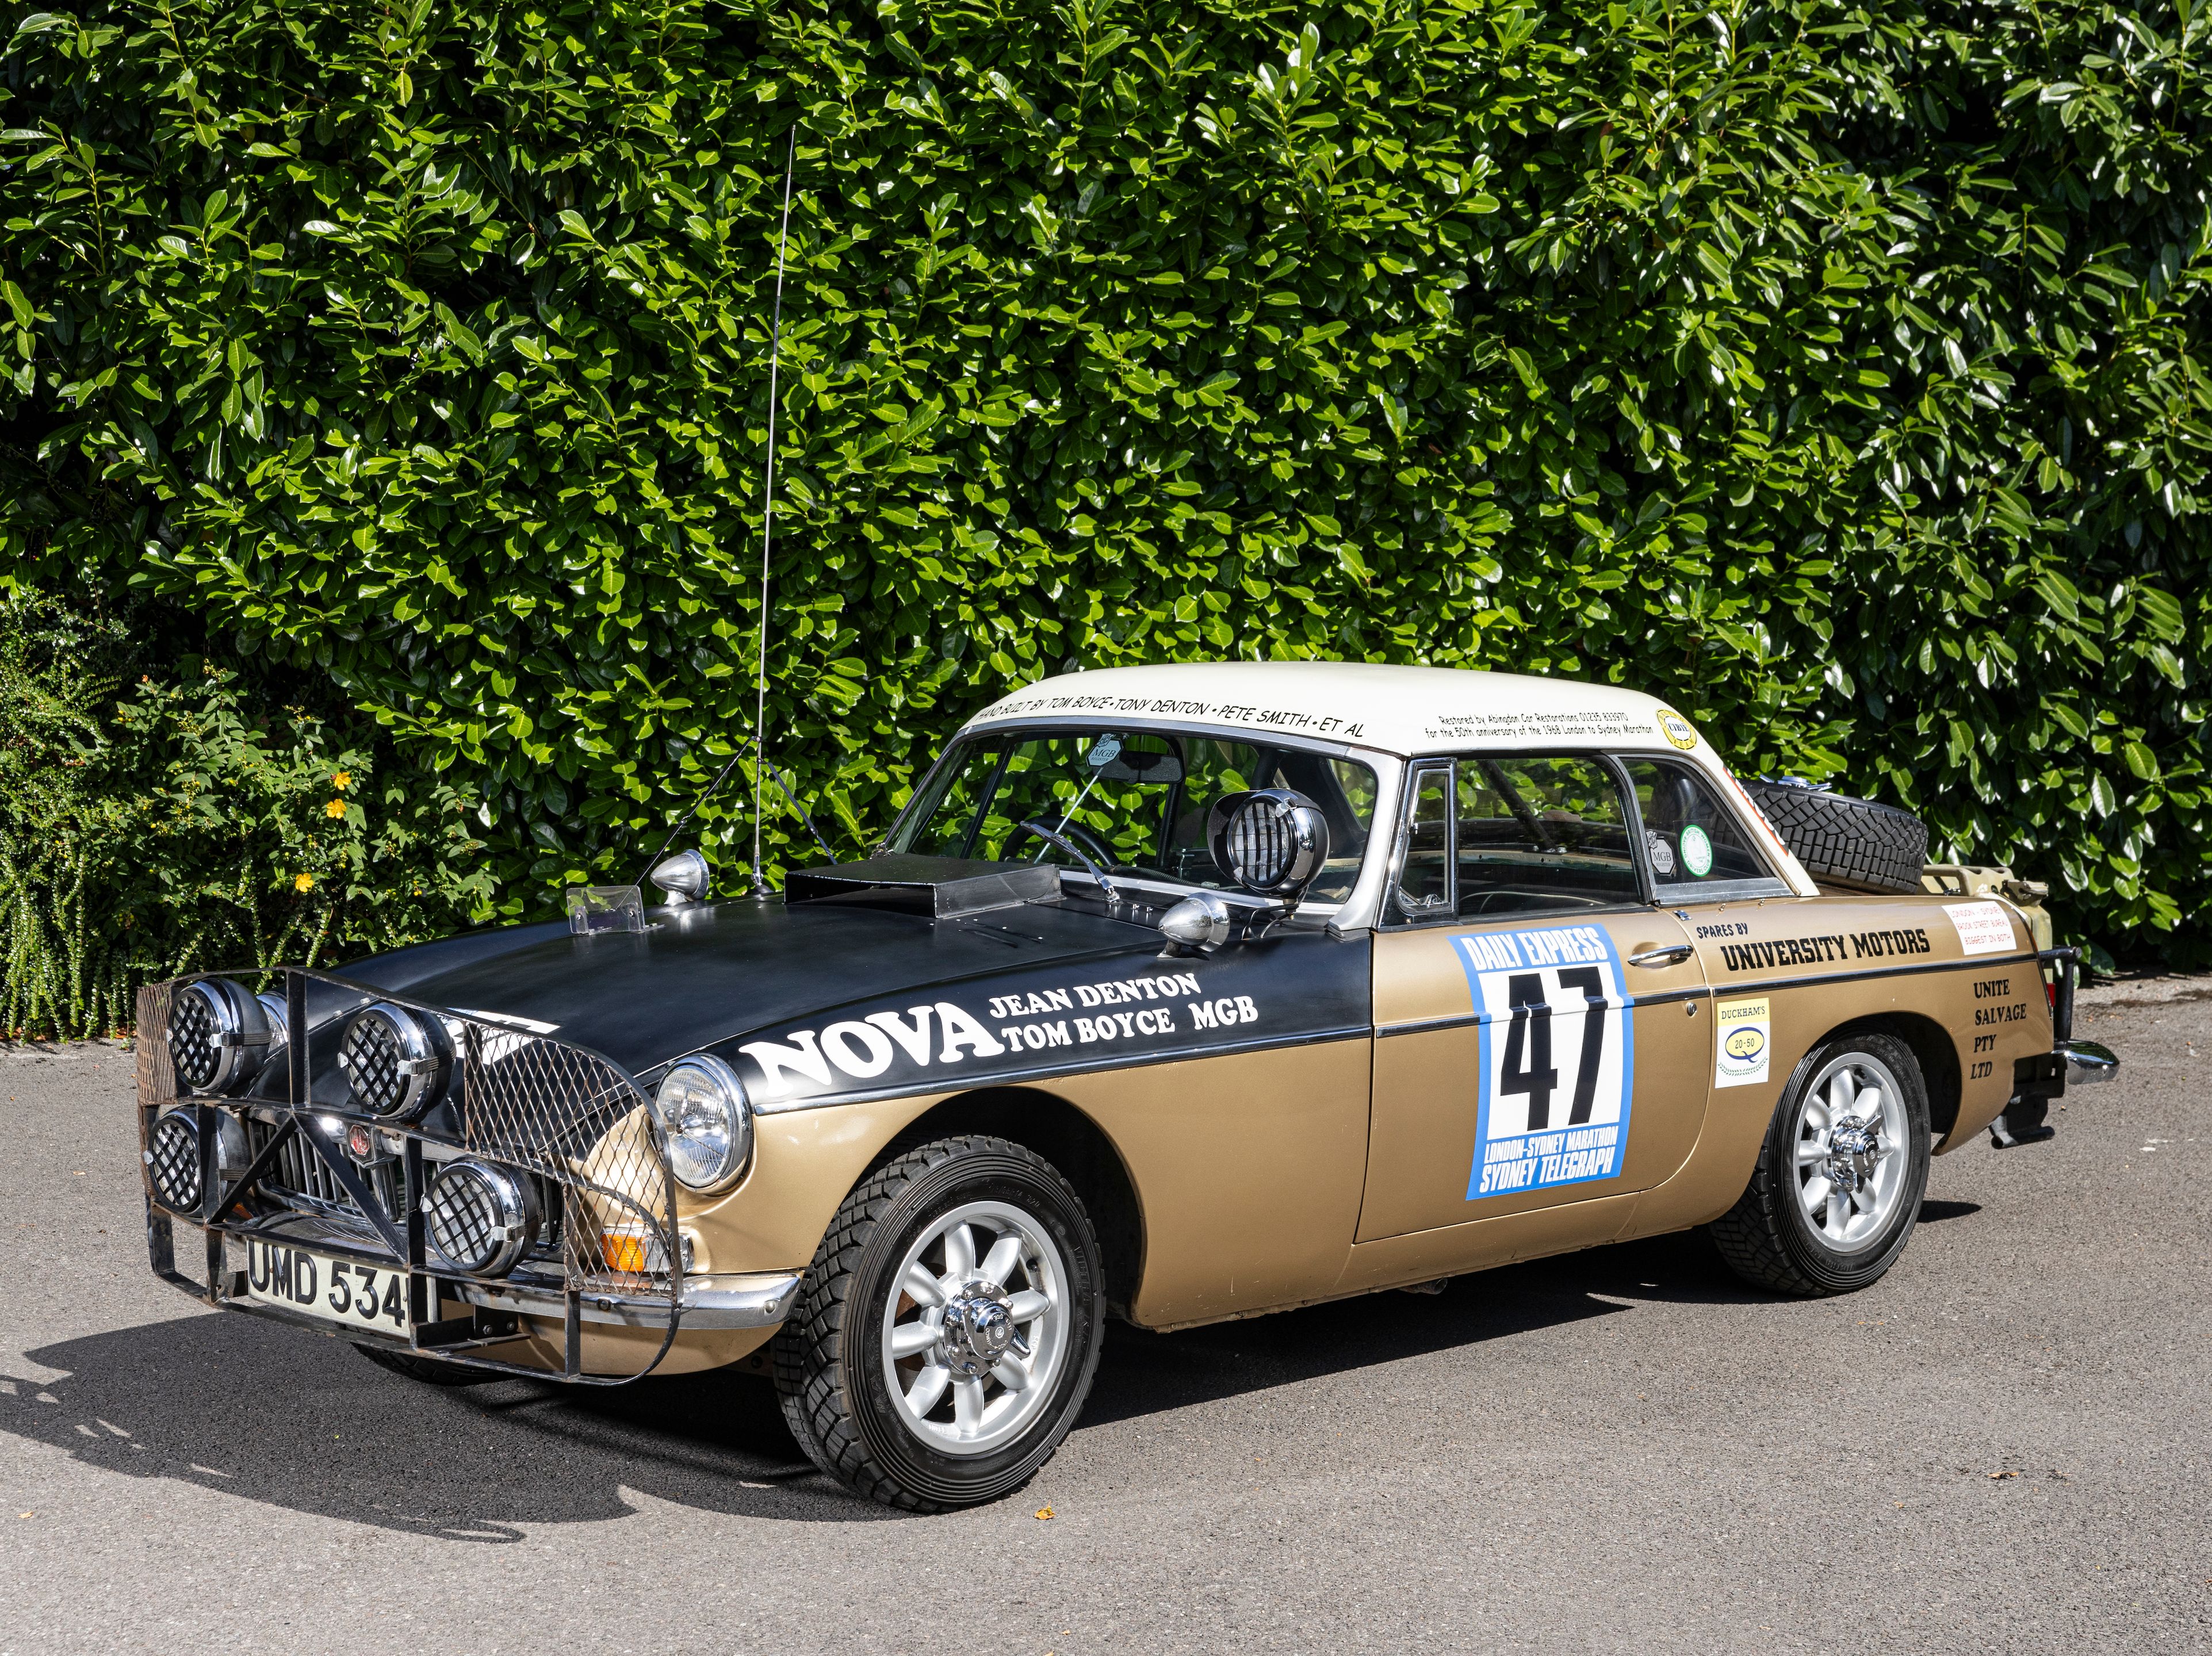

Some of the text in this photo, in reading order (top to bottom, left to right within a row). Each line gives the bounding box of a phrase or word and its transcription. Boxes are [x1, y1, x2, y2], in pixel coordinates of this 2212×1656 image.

[976, 696, 1364, 737] HAND BUILT BY TOM BOYCE TONY DENTON PETE SMITH ET AL
[1438, 712, 1628, 726] Restored by Abingdon Car Restorations 01235 833970
[1425, 723, 1654, 738] for the 50th anniversary of the 1968 London to Sydney Marathon
[1673, 738, 1694, 747] TEAM
[1092, 749, 1116, 757] MGB
[1653, 852, 1671, 862] MGB
[1951, 907, 2001, 918] LONDON SYDNEY
[1696, 922, 1748, 939] SPARES BY
[1973, 920, 1989, 929] STREET
[1990, 919, 2008, 927] BUREAU
[1964, 933, 2011, 945] BIGGEST IN BOTH
[1460, 927, 1608, 971] DAILY EXPRESS
[1720, 929, 1931, 972] UNIVERSITY MOTORS
[989, 972, 1201, 1019] JEAN DENTON
[1974, 979, 2010, 999] UNITE
[1721, 1006, 1766, 1019] DUCKHAM'S
[1975, 1003, 2027, 1026] SALVAGE
[1001, 996, 1259, 1053] TOM BOYCE MGB
[738, 1002, 1005, 1098] NOVA
[1500, 966, 1609, 1132] 47
[1974, 1034, 1997, 1053] PTY
[1970, 1061, 1992, 1080] LTD
[1566, 1125, 1619, 1152] MARATHON
[1479, 1146, 1617, 1194] SYDNEY TELEGRAPH
[248, 1240, 410, 1328] UMD 534
